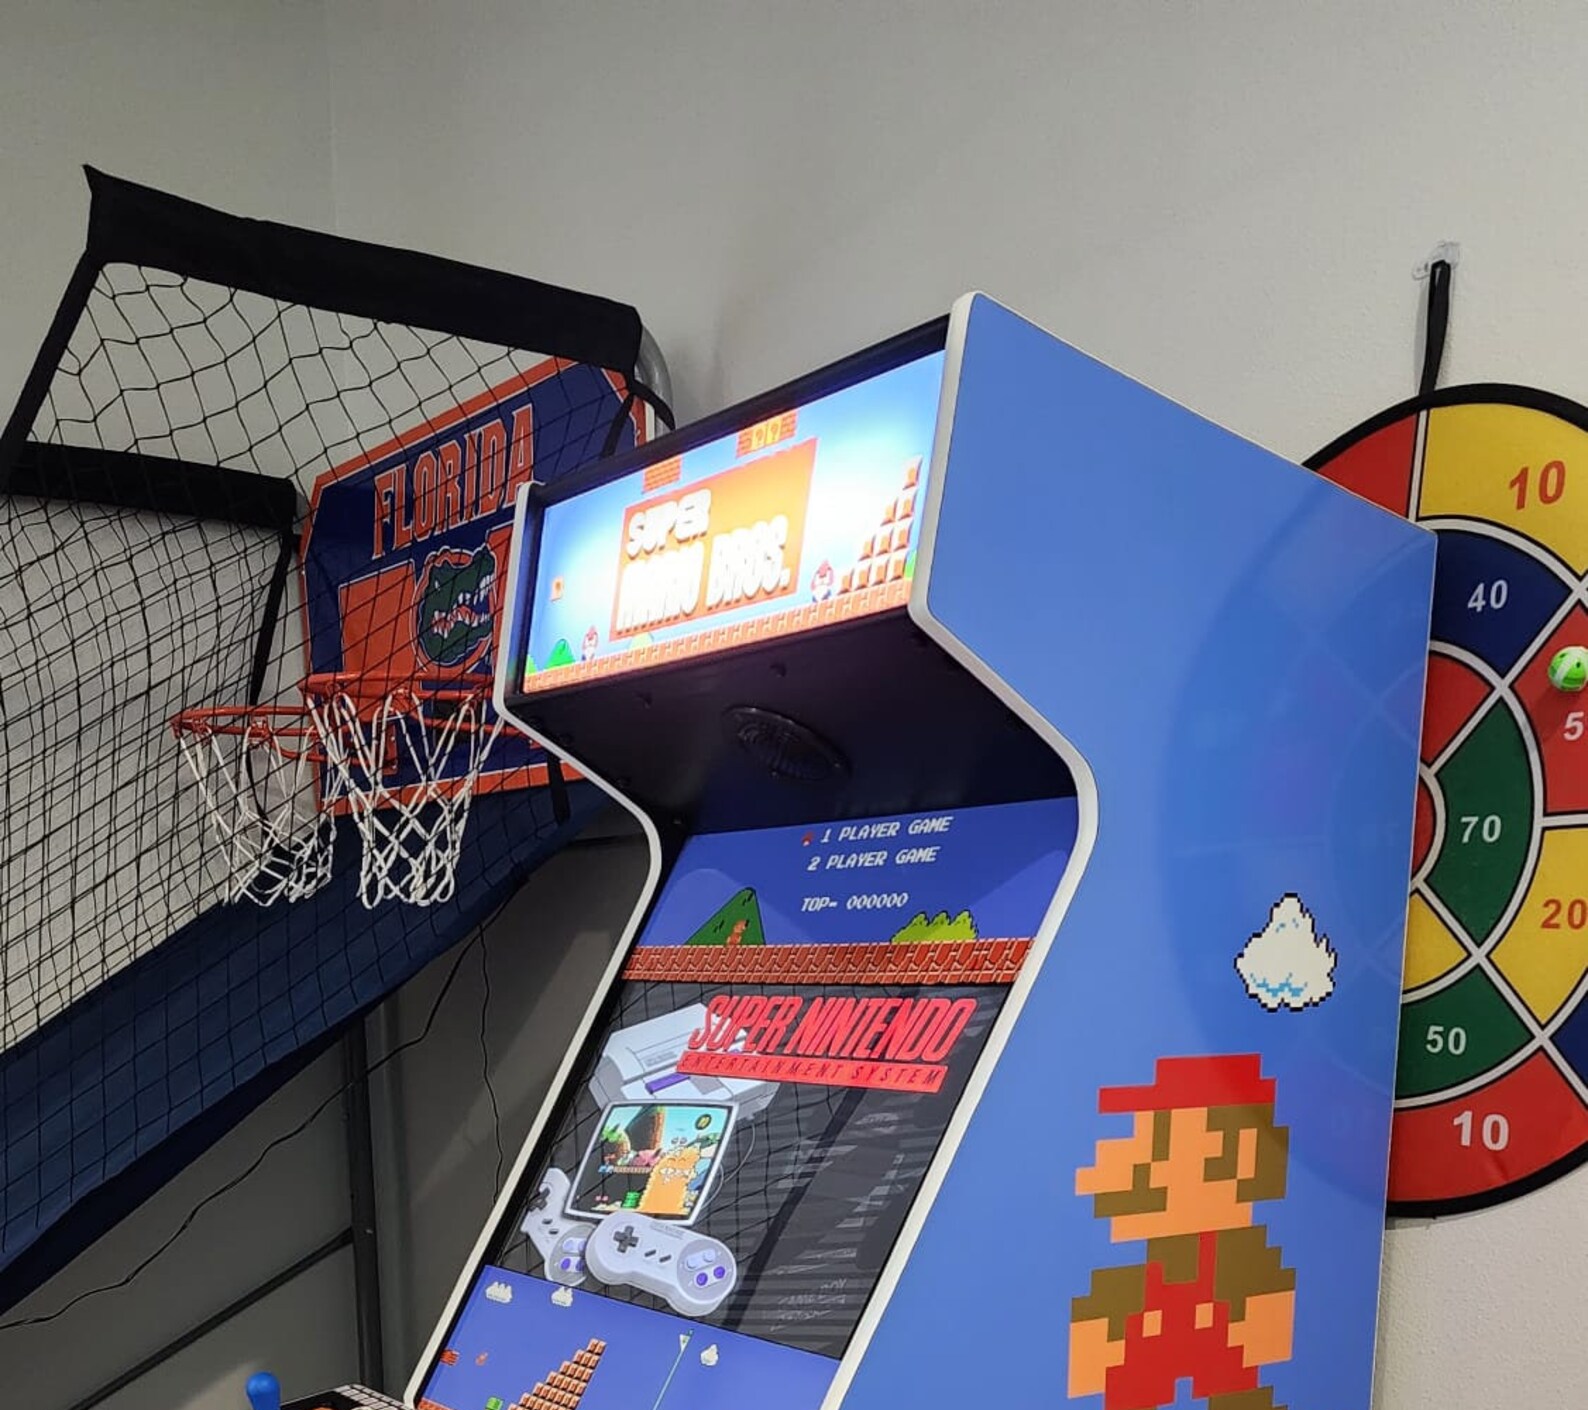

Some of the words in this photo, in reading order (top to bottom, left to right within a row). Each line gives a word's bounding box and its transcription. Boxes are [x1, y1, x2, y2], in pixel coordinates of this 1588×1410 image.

[373, 404, 535, 560] FLORIDA
[1508, 459, 1566, 511] 10
[1467, 578, 1508, 613] 40
[1563, 710, 1585, 741] 5
[820, 826, 832, 844] 1
[838, 821, 901, 843] PLAYER
[908, 816, 950, 835] GAME
[1460, 814, 1502, 844] 70
[806, 855, 820, 872] 2
[825, 849, 889, 870] PLAYER
[895, 845, 938, 865] GAME
[846, 891, 908, 911] 000000
[1540, 897, 1588, 930] 20
[687, 994, 803, 1053] SUPER
[789, 995, 978, 1063] NINTENDO
[1425, 1024, 1467, 1056] 50
[850, 1064, 942, 1087] SYSTEM
[1451, 1109, 1509, 1152] 10
